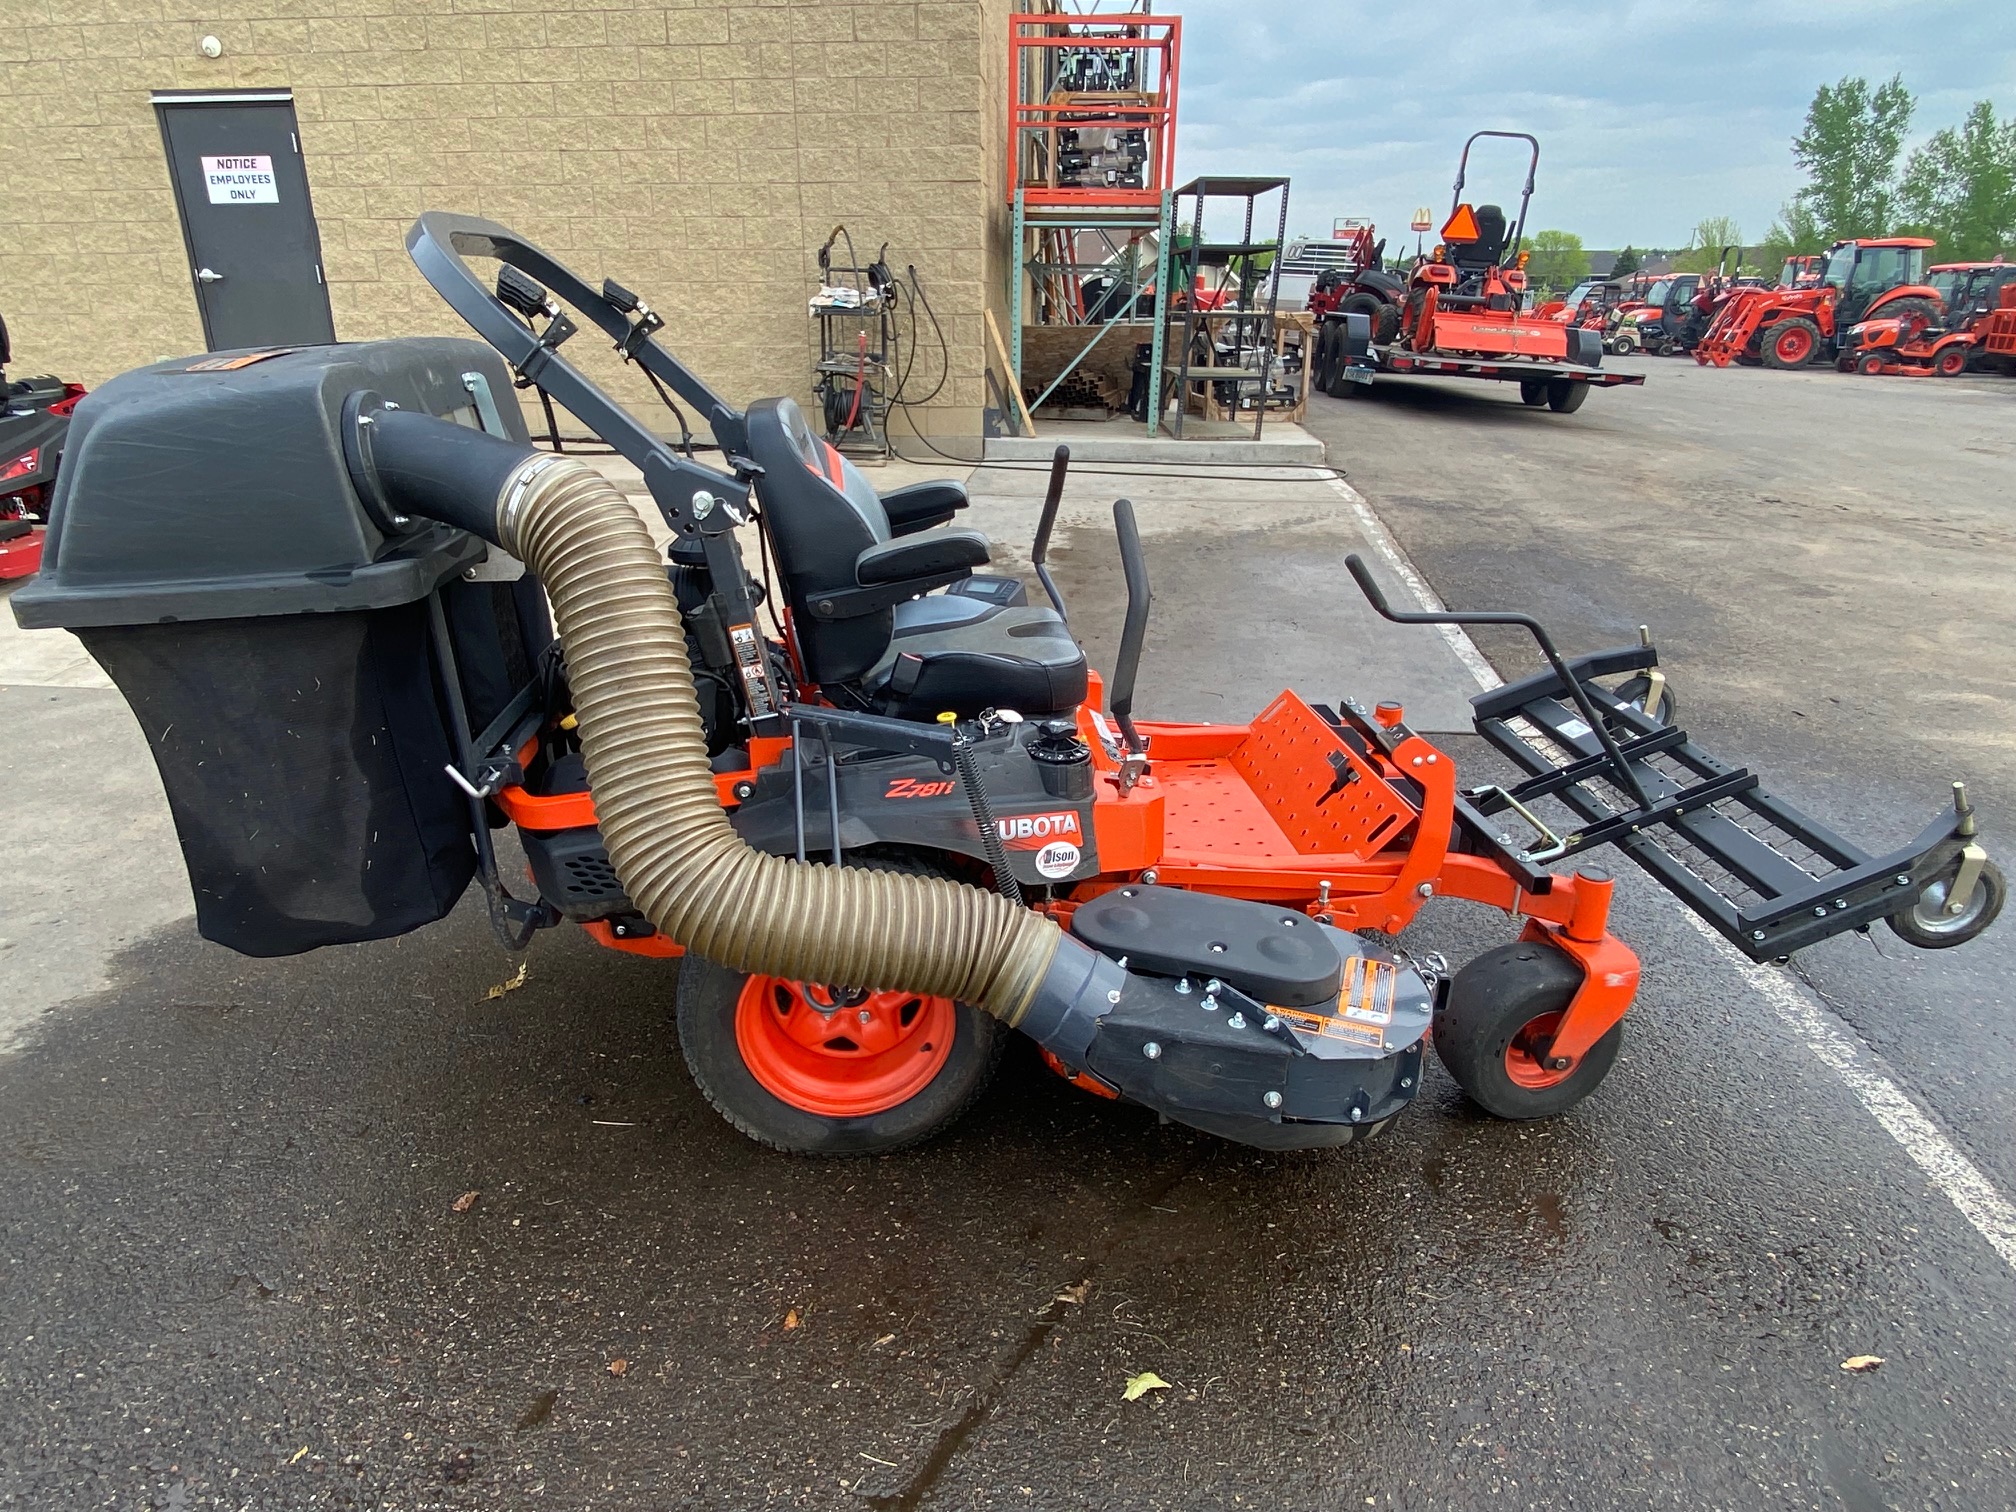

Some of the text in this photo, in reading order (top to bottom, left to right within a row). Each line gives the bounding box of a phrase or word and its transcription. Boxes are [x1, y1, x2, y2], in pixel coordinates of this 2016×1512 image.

[217, 158, 257, 169] NOTICE
[210, 174, 271, 185] EMPLOYEES
[230, 190, 256, 200] ONLY
